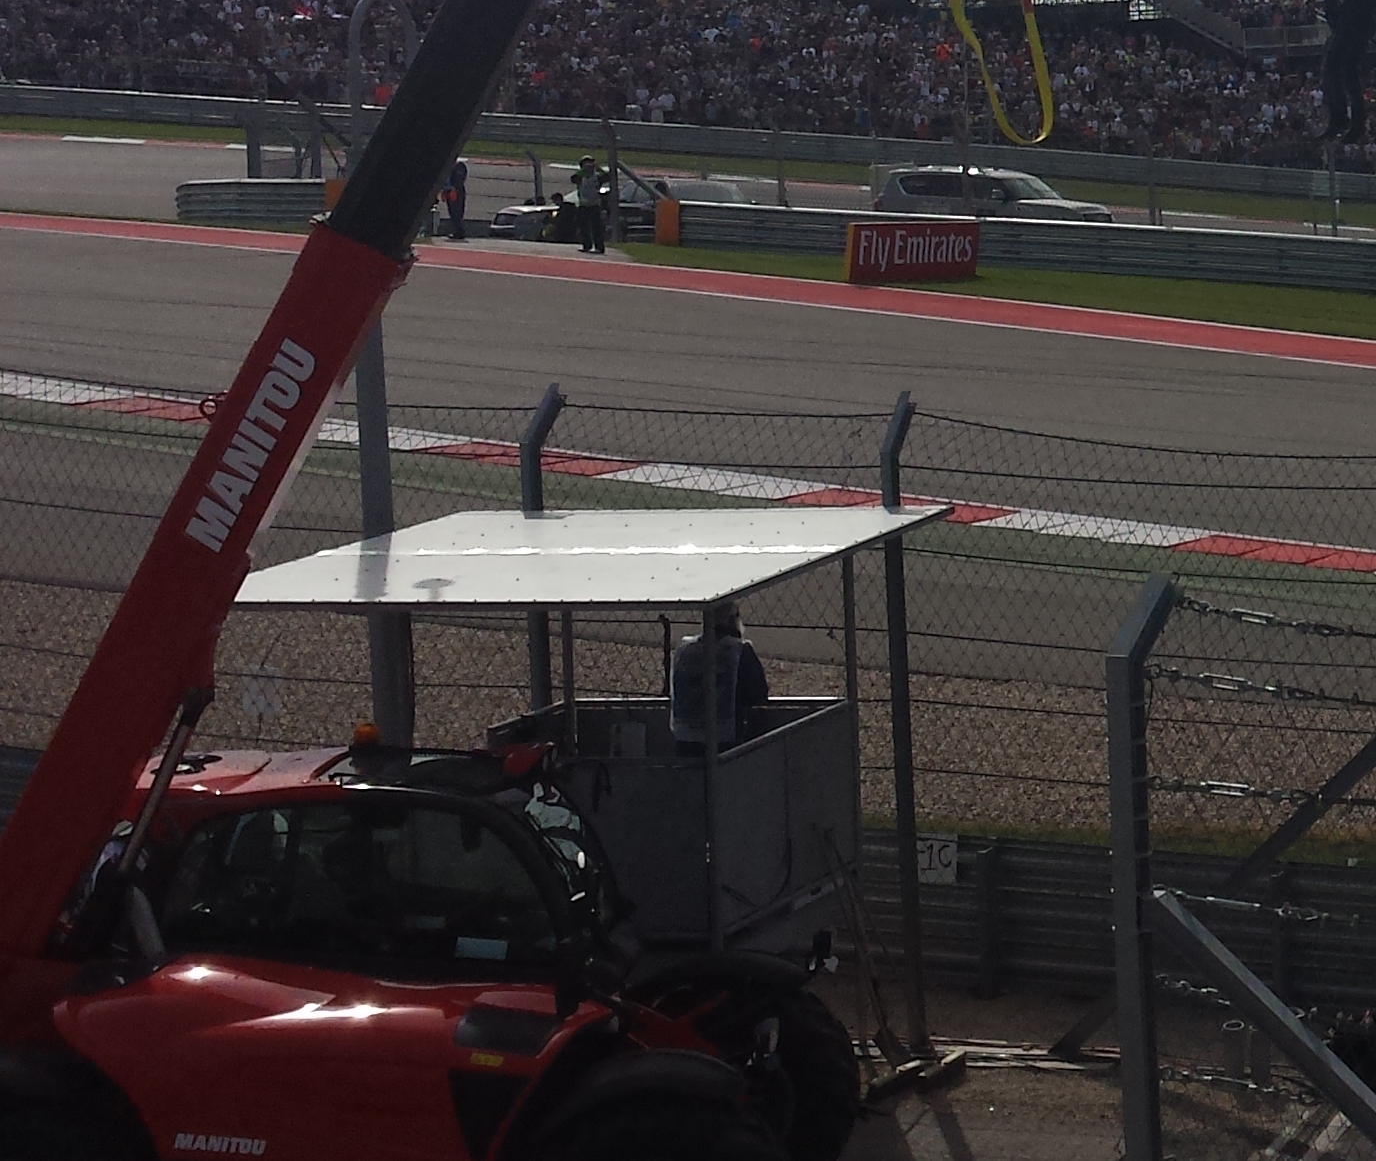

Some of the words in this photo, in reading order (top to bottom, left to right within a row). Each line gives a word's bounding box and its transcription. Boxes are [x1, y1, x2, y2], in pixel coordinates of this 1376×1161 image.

[859, 230, 891, 273] Fly
[894, 227, 973, 264] Emirates
[185, 338, 316, 553] MANITOU
[174, 1133, 266, 1156] MANITOU
